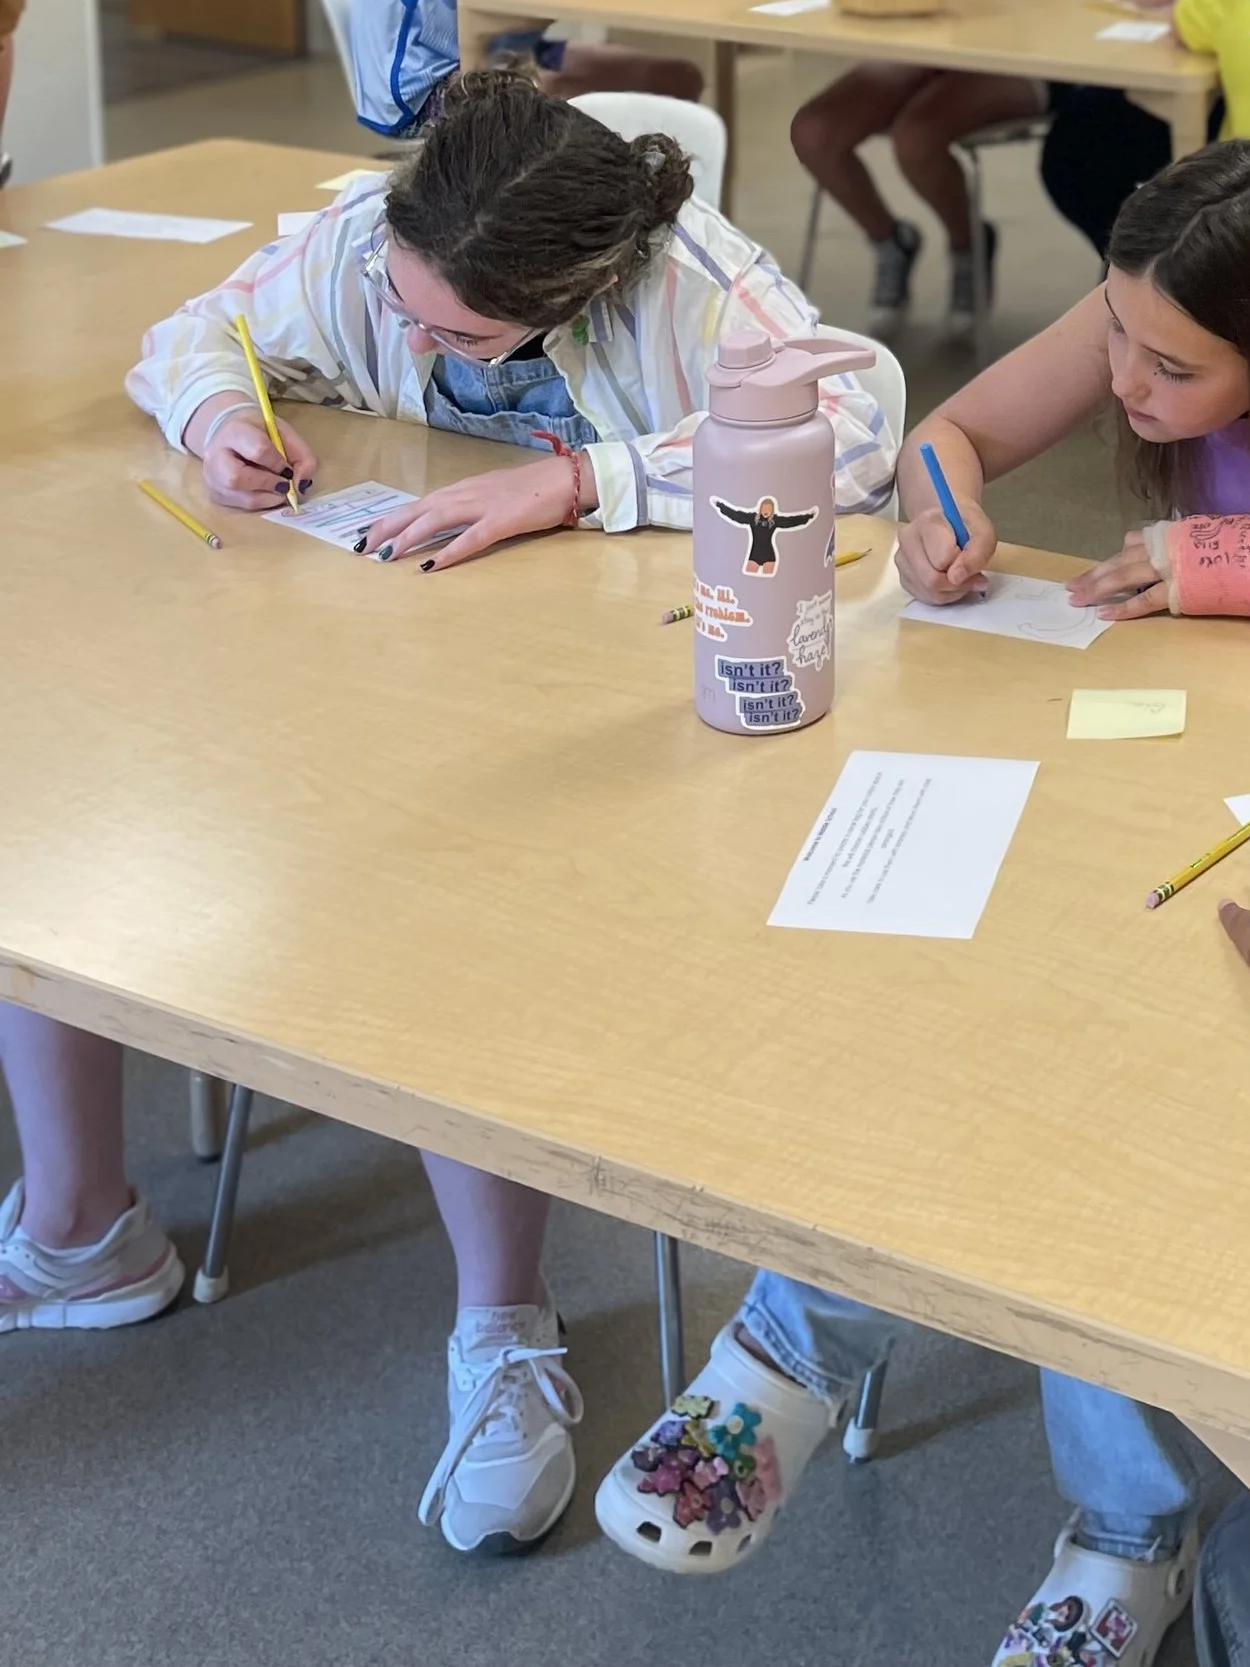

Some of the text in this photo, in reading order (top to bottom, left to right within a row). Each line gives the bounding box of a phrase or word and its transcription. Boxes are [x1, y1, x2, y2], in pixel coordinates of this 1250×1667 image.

[721, 661, 781, 677] isn't it?
[733, 678, 790, 693] isn't it?
[744, 694, 795, 711] isn't it?
[749, 709, 800, 723] isn't it?
